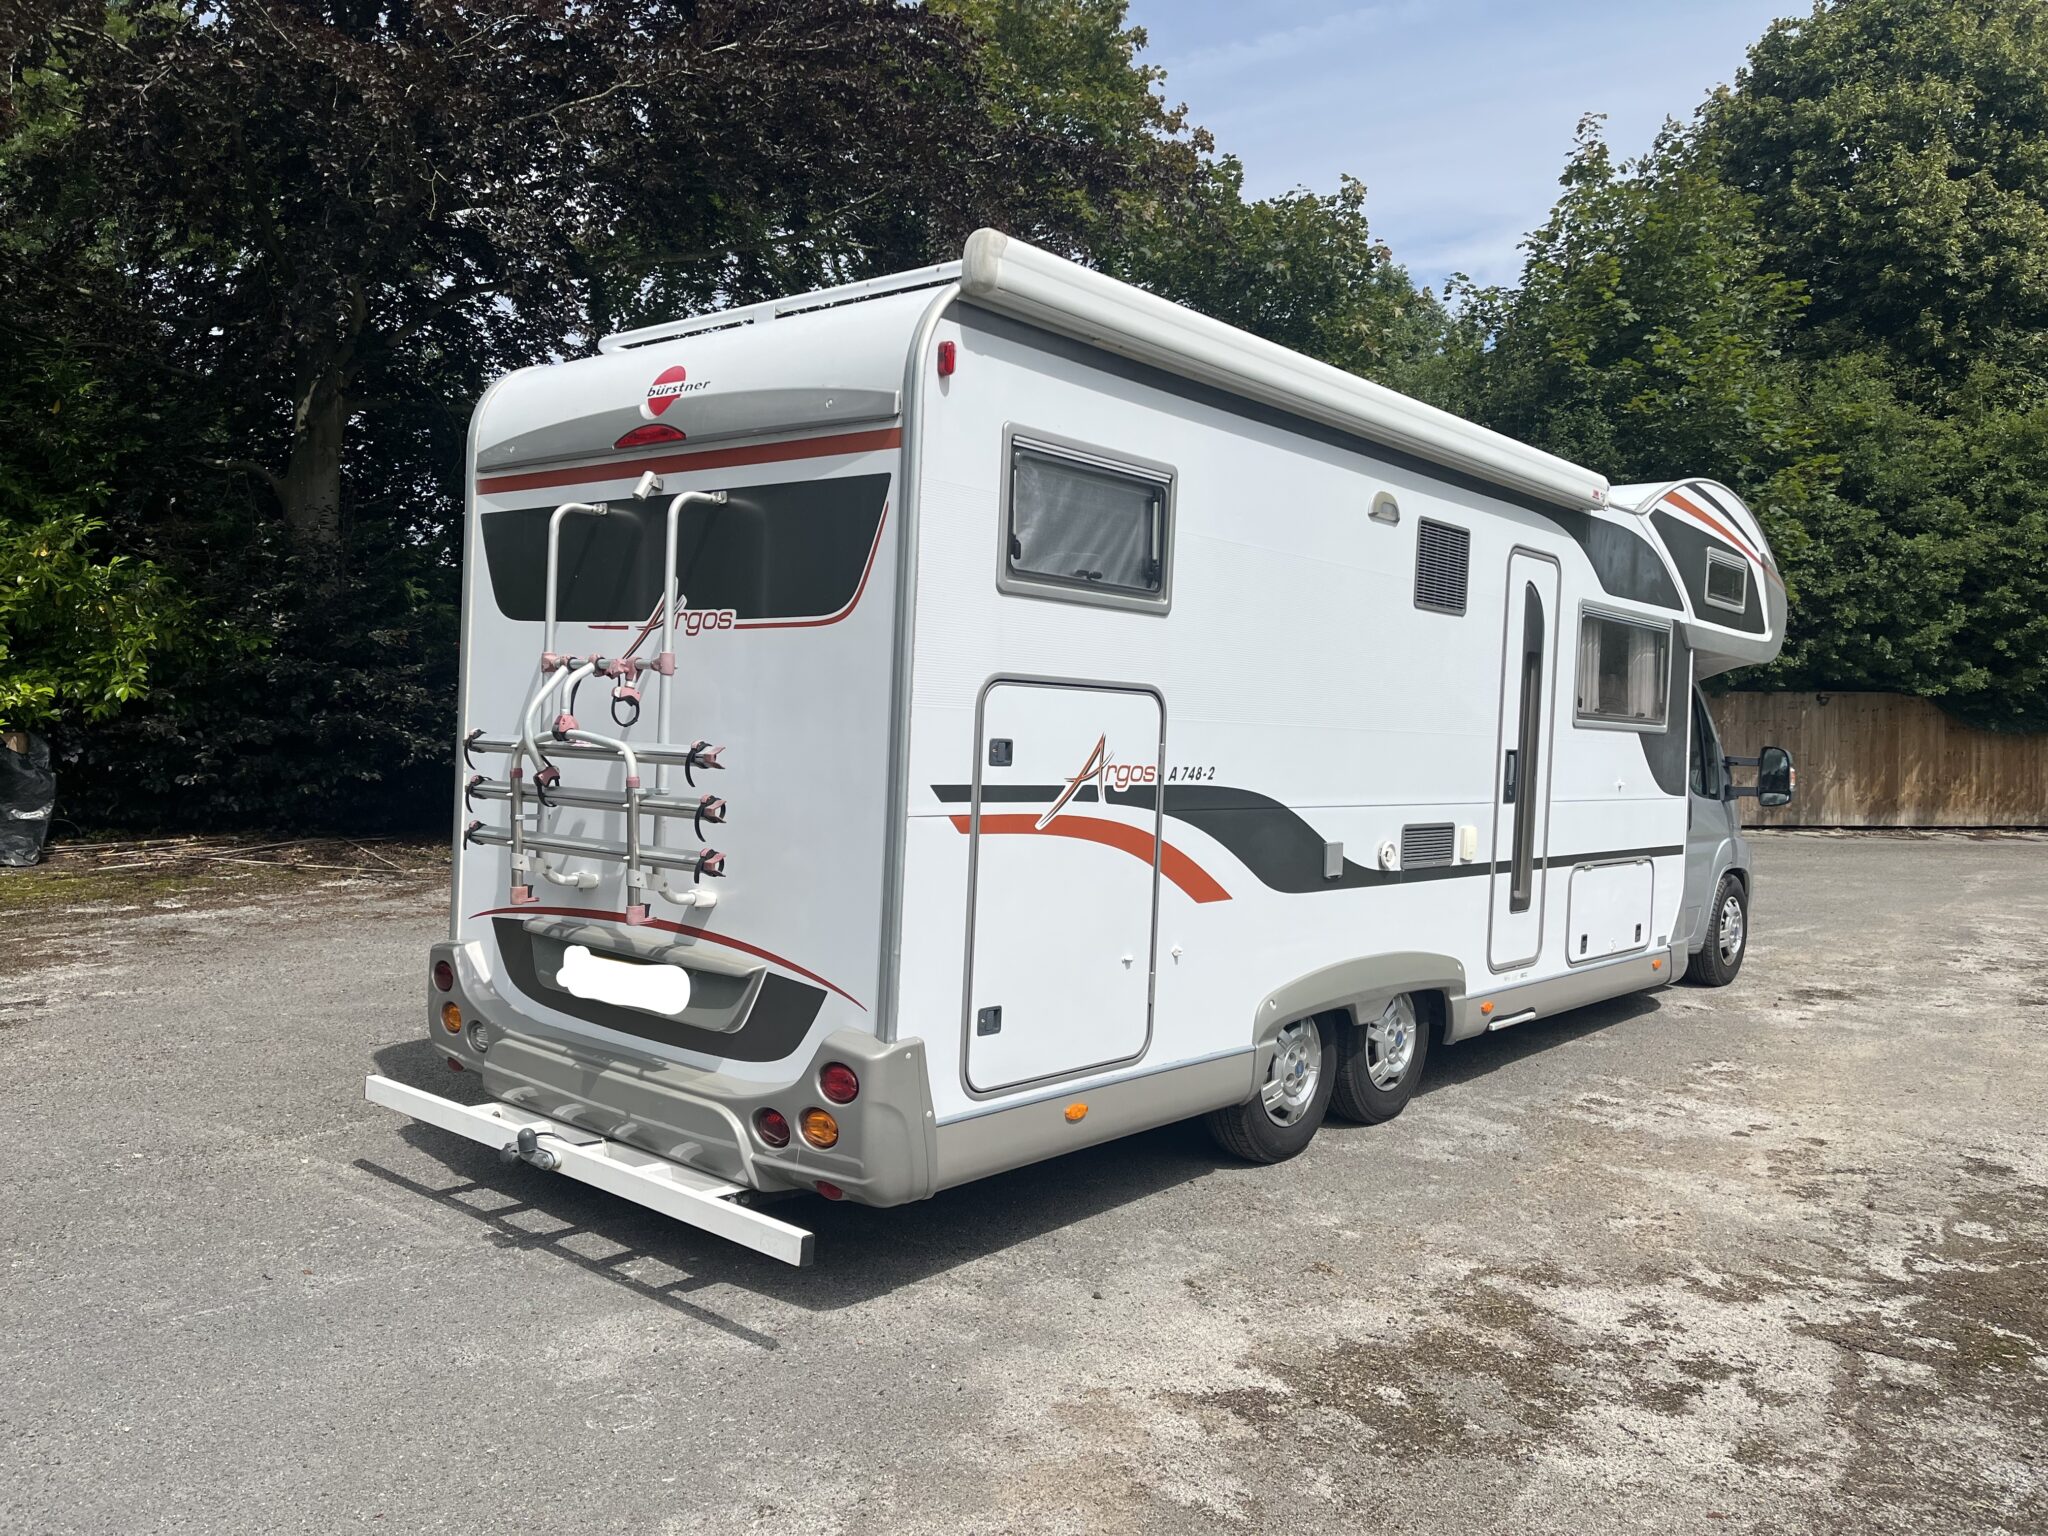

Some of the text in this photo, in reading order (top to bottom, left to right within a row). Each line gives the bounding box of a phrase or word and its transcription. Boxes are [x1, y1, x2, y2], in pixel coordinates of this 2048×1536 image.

[647, 380, 711, 397] bürstner
[622, 590, 733, 660] Argos
[1039, 732, 1216, 828] Argos A 748-2
